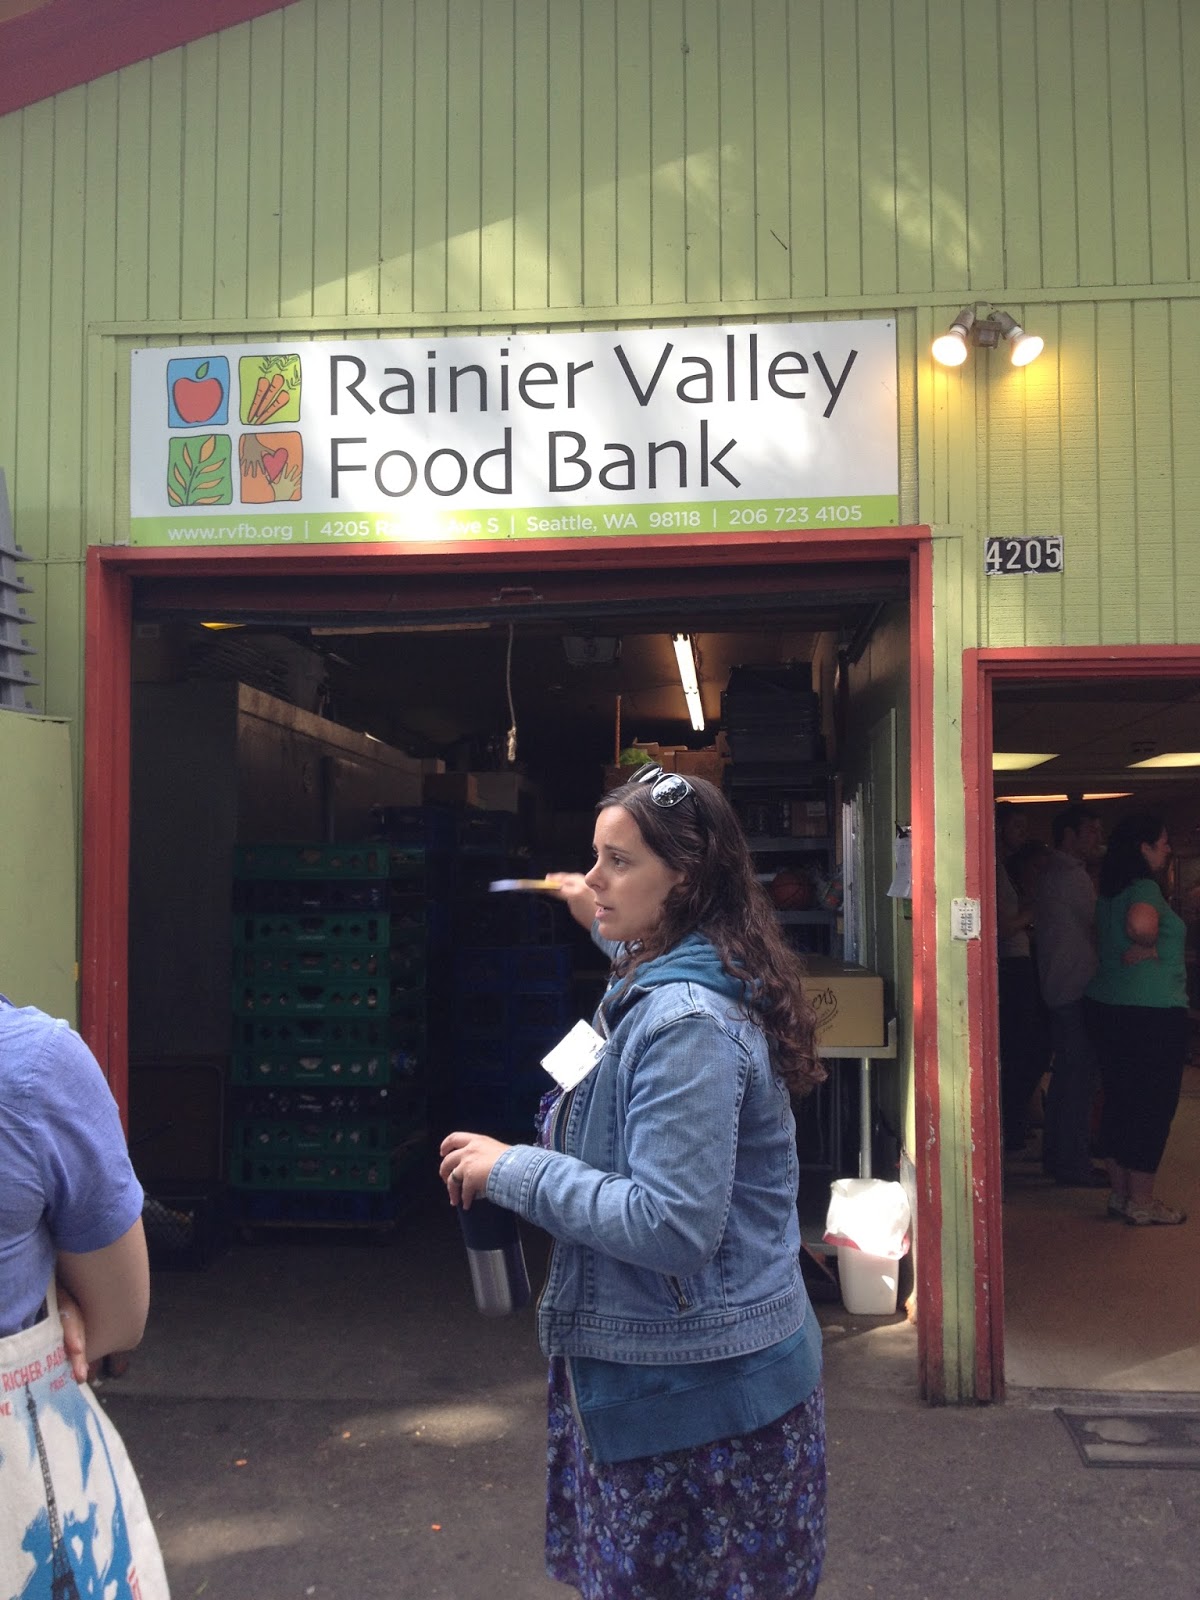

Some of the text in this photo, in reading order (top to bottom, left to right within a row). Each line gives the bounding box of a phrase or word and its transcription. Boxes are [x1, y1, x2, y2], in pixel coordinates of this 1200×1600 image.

[330, 333, 858, 418] Rainier Valley
[331, 419, 742, 498] Food Bank
[320, 521, 370, 537] 4205
[487, 517, 499, 533] S
[526, 510, 701, 533] Seattle, WA 98118
[729, 505, 862, 526] 206 723 4105
[168, 523, 293, 541] www.rvfb.org
[986, 539, 1061, 570] 4205
[1, 1360, 43, 1393] RICHER
